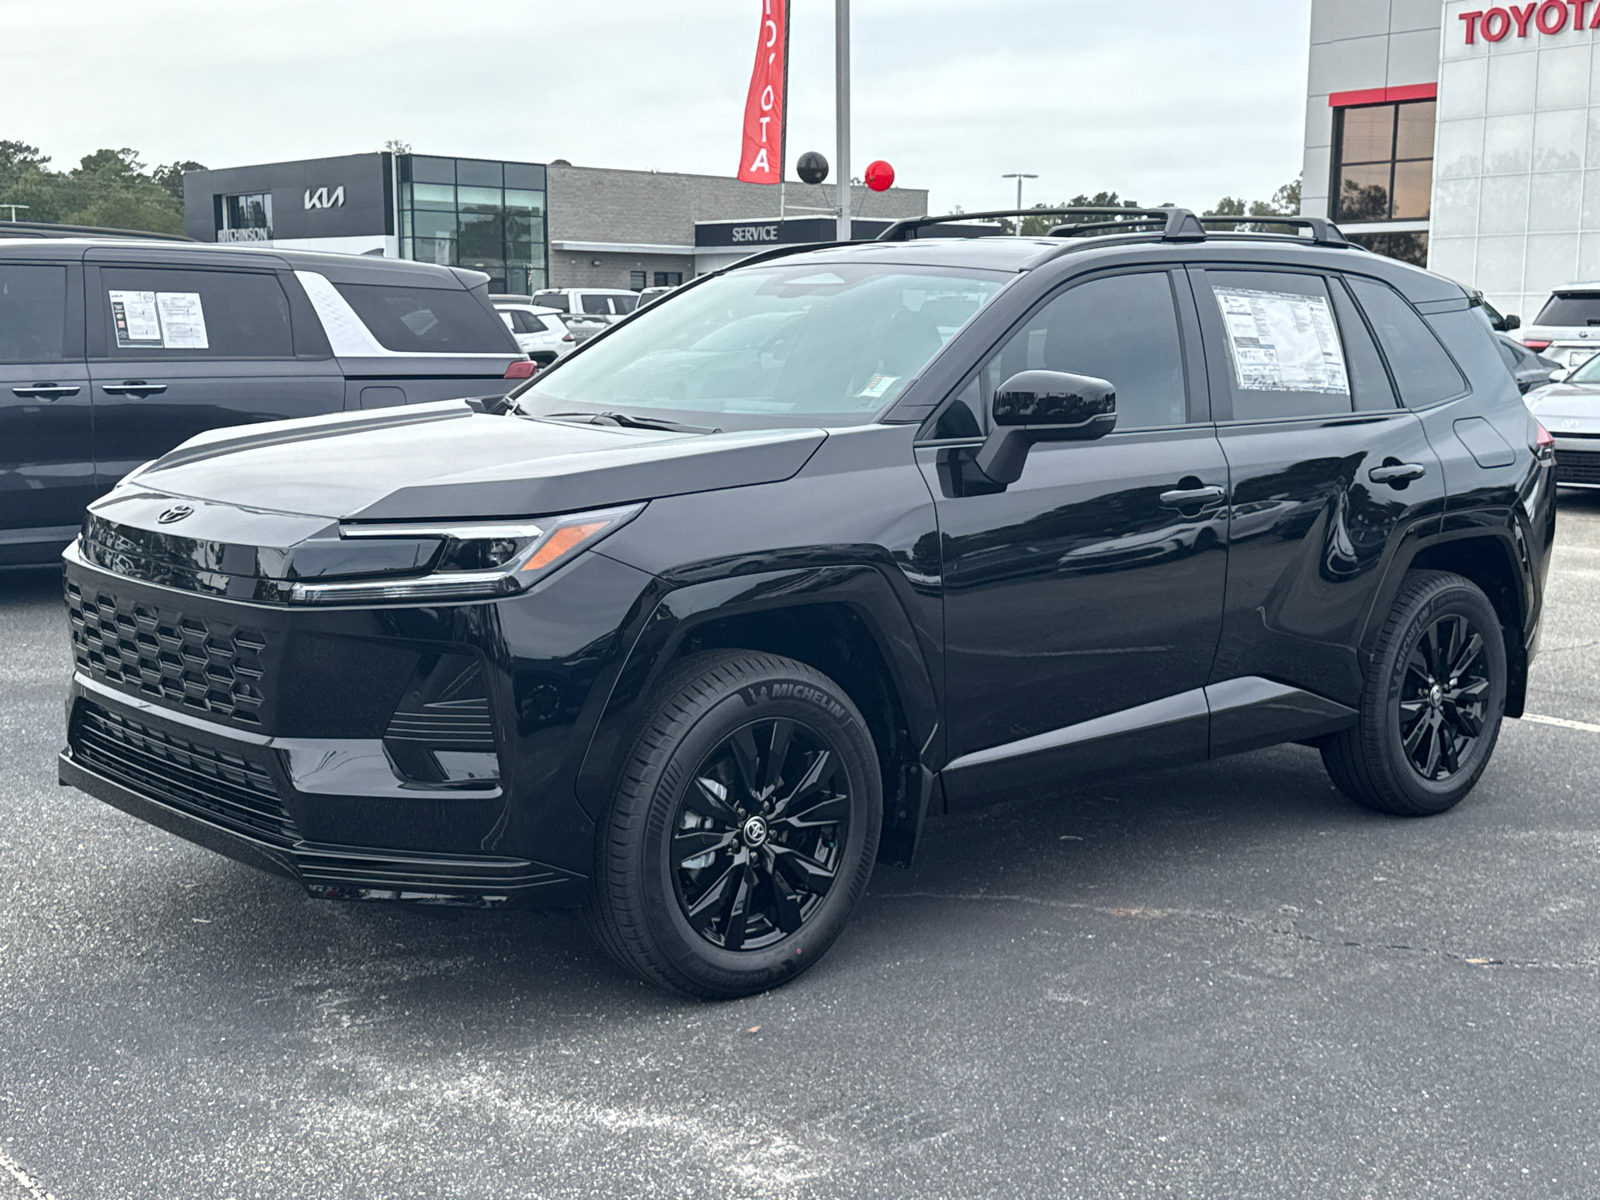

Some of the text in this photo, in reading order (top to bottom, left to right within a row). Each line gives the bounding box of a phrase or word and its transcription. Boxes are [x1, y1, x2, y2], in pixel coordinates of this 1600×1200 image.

[304, 185, 345, 210] KIA
[217, 227, 269, 243] HUTCHINSON
[732, 225, 779, 243] SERVICE
[1396, 606, 1430, 672] MICHELIN
[771, 682, 846, 720] MICHELIN
